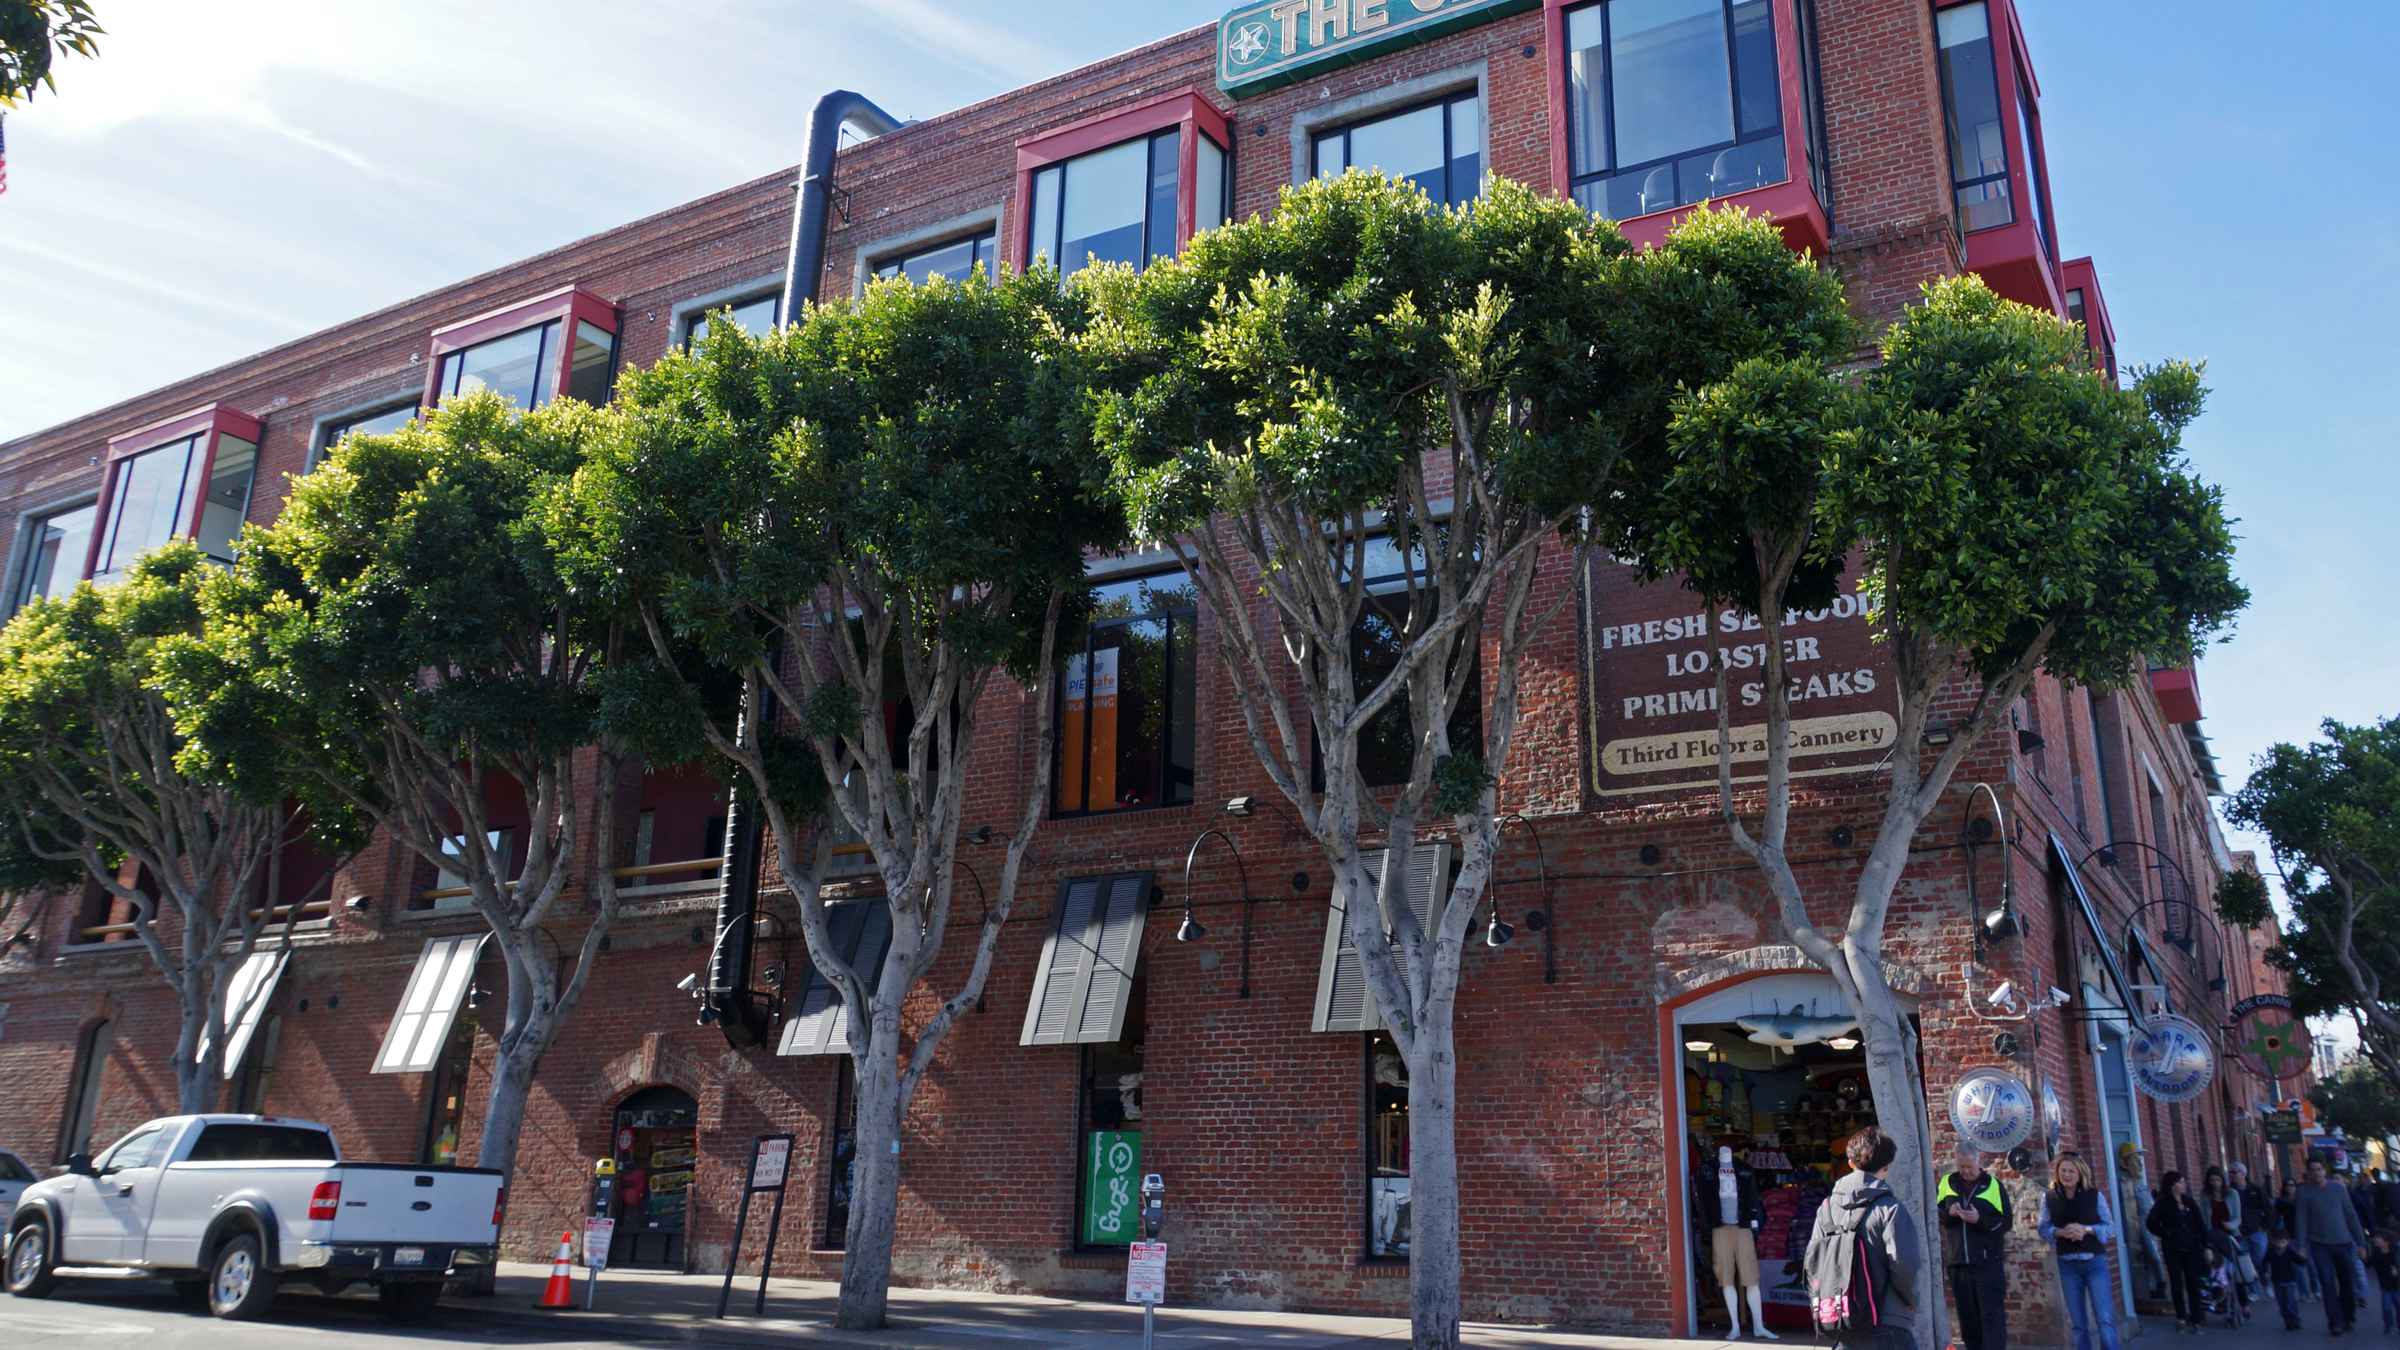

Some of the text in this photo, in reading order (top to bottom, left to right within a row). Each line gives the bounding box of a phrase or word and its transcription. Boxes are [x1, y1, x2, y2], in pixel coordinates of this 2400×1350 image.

[1271, 0, 1390, 57] THE
[1601, 613, 1708, 649] FRESH
[1740, 668, 1876, 707] SEAKS
[1617, 742, 1679, 765] Third
[1788, 727, 1885, 749] Cannery
[1962, 1081, 2015, 1105] WHARF
